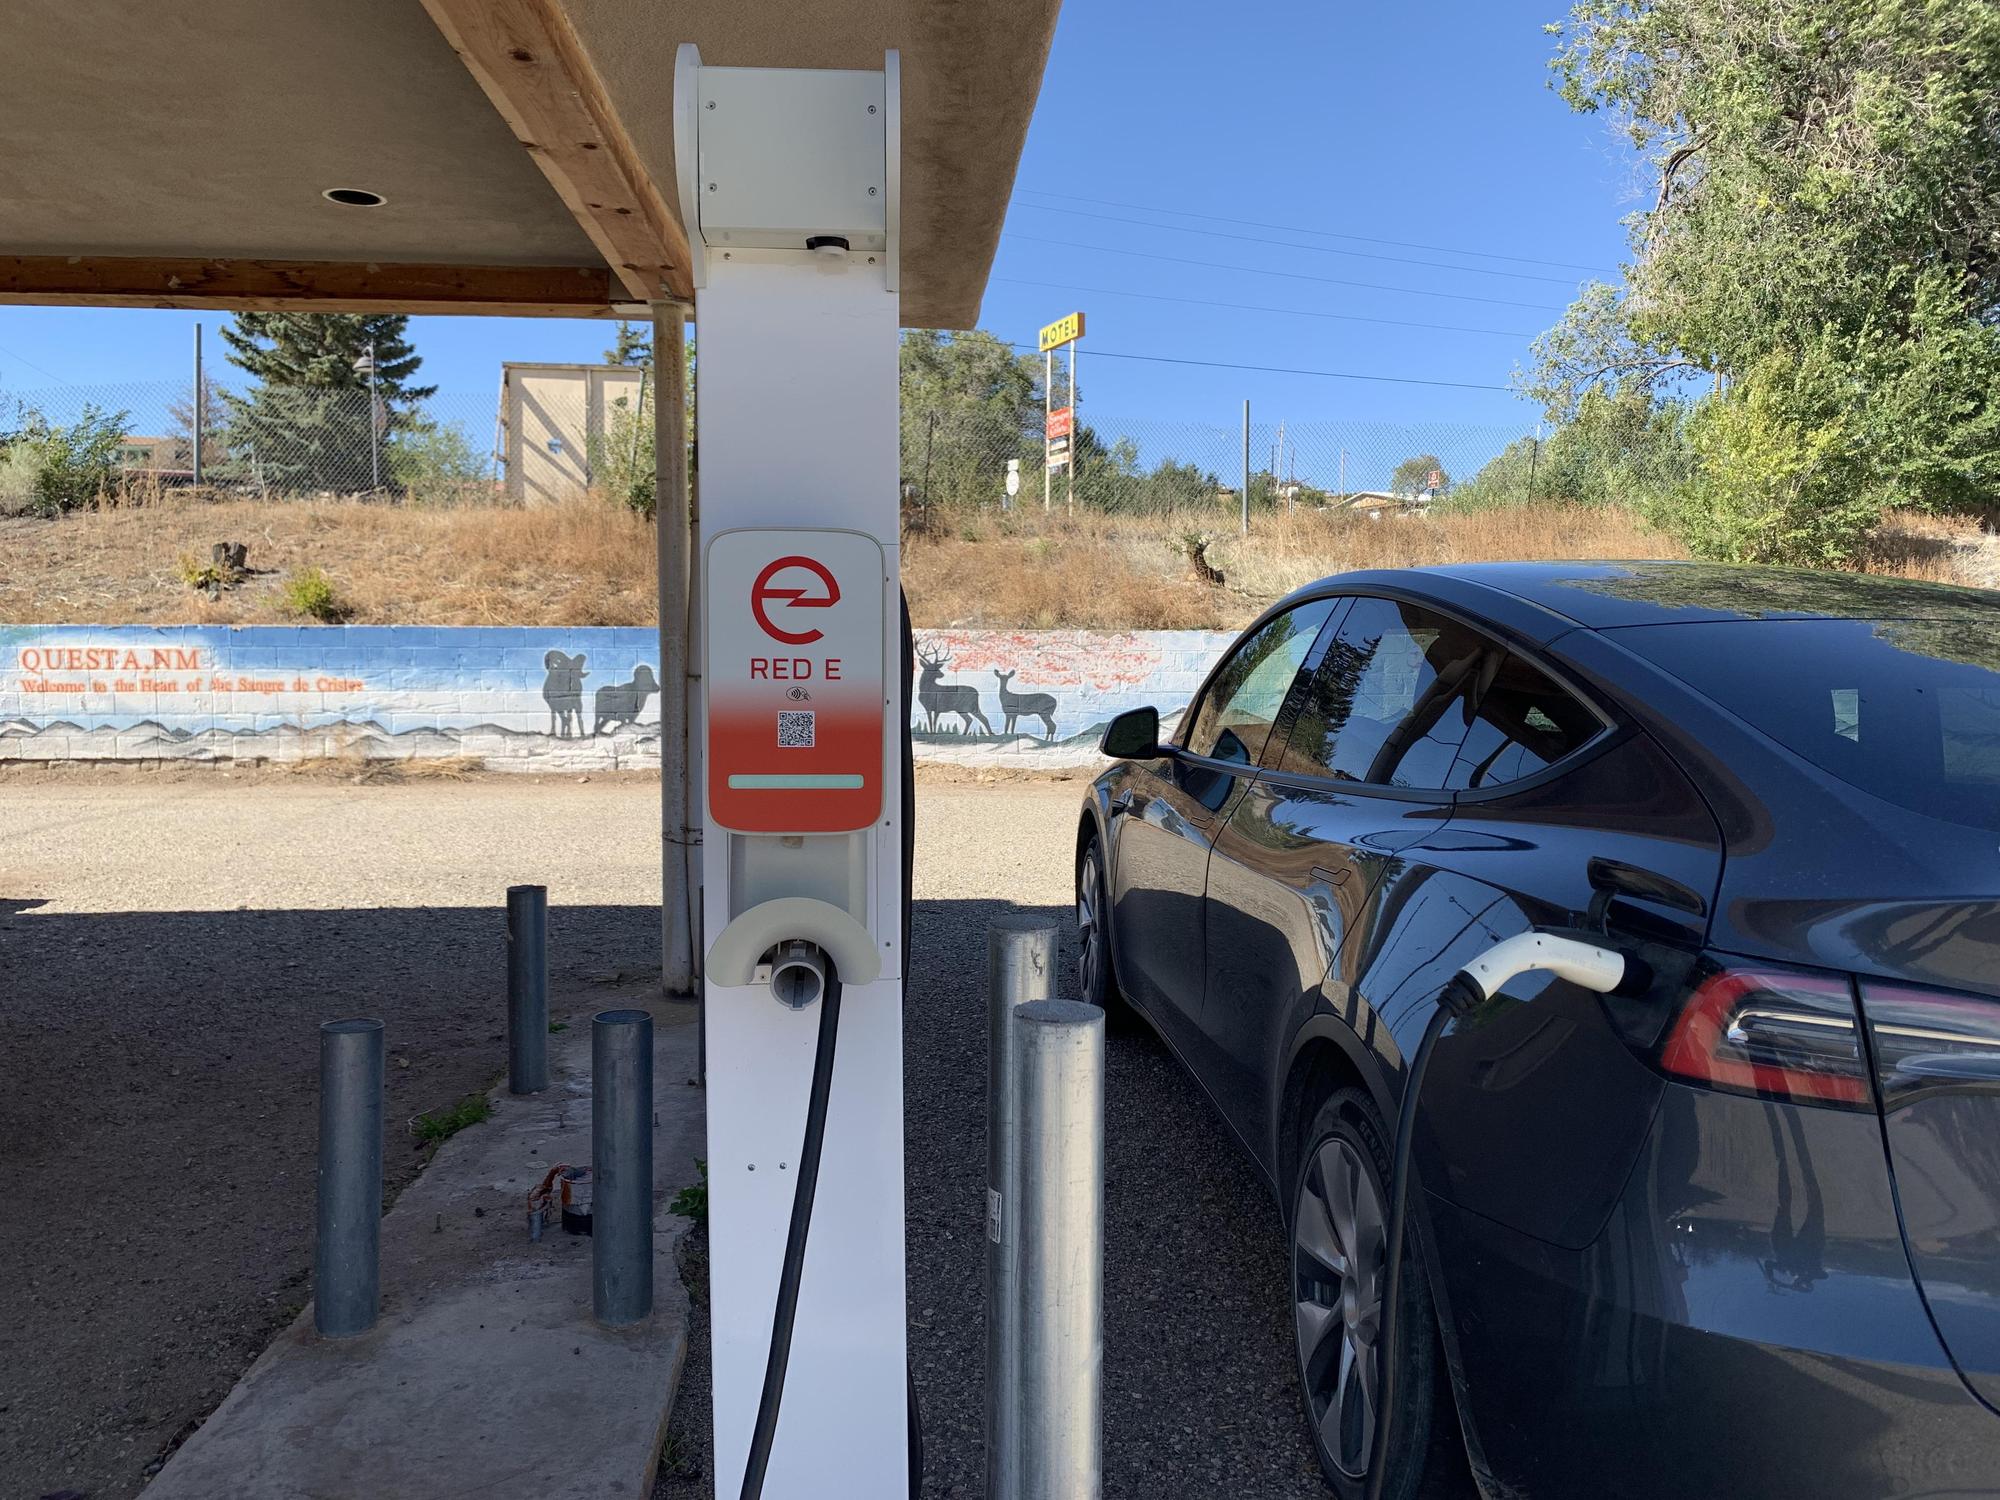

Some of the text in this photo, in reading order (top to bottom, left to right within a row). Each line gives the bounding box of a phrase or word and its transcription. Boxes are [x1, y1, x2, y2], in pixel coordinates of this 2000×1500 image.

[1042, 318, 1076, 346] MOTEL
[750, 657, 841, 680] RED E
[21, 679, 86, 693] Welcome
[93, 680, 107, 693] to
[115, 679, 135, 693] the
[140, 679, 178, 693] Heart
[187, 678, 202, 692] of
[239, 677, 284, 695] Sangre
[292, 678, 309, 692] de
